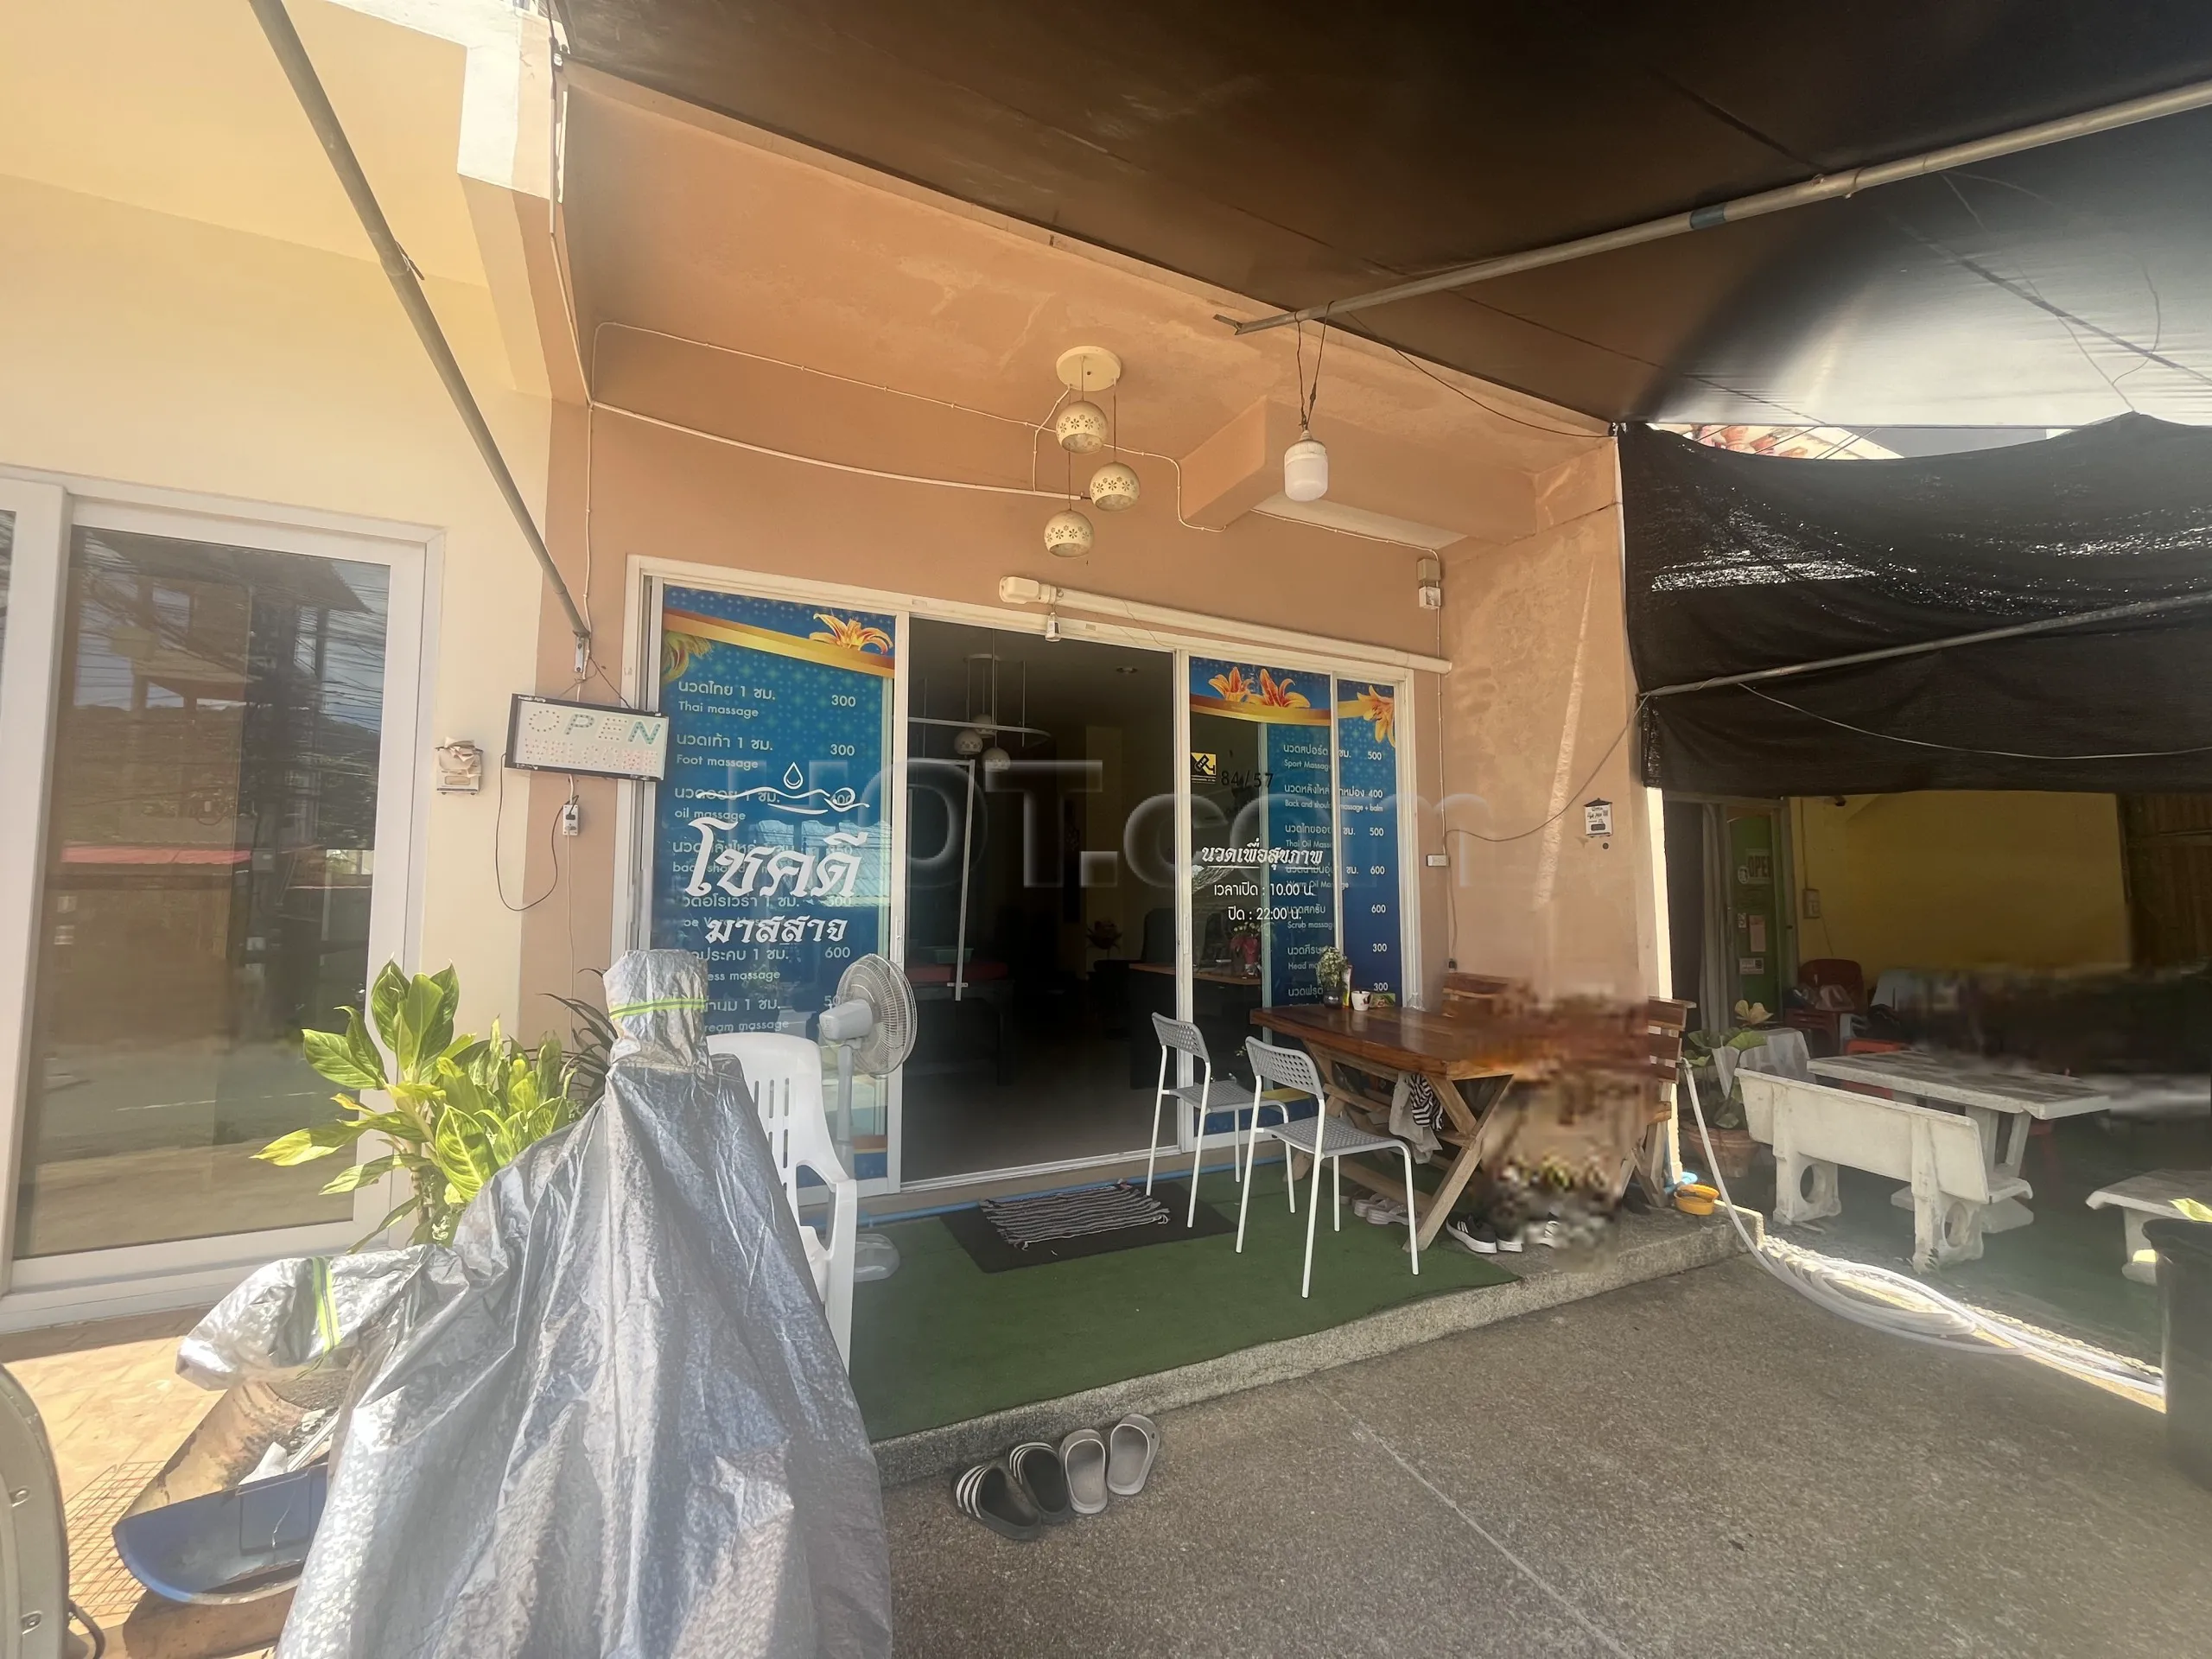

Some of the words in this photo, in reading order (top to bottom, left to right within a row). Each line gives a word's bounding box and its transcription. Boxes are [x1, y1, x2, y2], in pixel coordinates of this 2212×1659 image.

[678, 680, 733, 696] นวดไทย
[741, 686, 746, 696] 1
[753, 688, 775, 700] ชม.
[831, 695, 855, 708] 300
[678, 701, 702, 713] Thai
[708, 705, 759, 719] massage
[528, 710, 661, 745] OPEN
[677, 733, 730, 748] นวดเท้า
[738, 737, 743, 748] 1
[751, 739, 773, 751] ชม.
[830, 744, 855, 756] 300
[525, 737, 658, 772] WELCOME
[1368, 751, 1382, 760] 500
[677, 754, 702, 766] Foot
[707, 758, 759, 771] massage
[1284, 760, 1301, 769] Sport
[1304, 761, 1330, 772] Massag
[1221, 770, 1274, 787] 84/57
[758, 791, 780, 803] ชม.
[1369, 790, 1382, 798] 400
[1301, 799, 1313, 808] and
[1370, 804, 1383, 812] balm
[675, 808, 690, 819] oil
[694, 810, 746, 822] massage
[1343, 827, 1356, 836] ชม.
[1370, 827, 1383, 836] 500
[1286, 839, 1300, 848] Thai
[1302, 839, 1312, 848] Oil
[686, 817, 868, 897] โชคดี
[1201, 837, 1324, 871] นวดเพื่อสุขภาพ
[1346, 866, 1359, 874] ชม.
[1370, 866, 1385, 874] 600
[1214, 883, 1258, 897] เวลาเปิด
[1270, 883, 1300, 896] 10.00
[778, 896, 799, 907] ชม.
[1228, 906, 1245, 921] ปิด
[1256, 907, 1287, 920] 22:00
[1371, 904, 1386, 913] 600
[705, 916, 848, 944] มาสสาจ
[1287, 920, 1306, 930] Scrub
[1308, 922, 1334, 931] massag
[753, 949, 759, 960] 1
[766, 949, 789, 960] ชม.
[825, 946, 851, 959] 600
[1372, 943, 1388, 952] 300
[1288, 961, 1306, 970] Head
[729, 970, 780, 983] massage
[1374, 982, 1389, 992] 300
[745, 999, 750, 1011] 1
[759, 999, 780, 1011] ชม.
[704, 1023, 734, 1034] ream
[739, 1020, 789, 1033] massage
